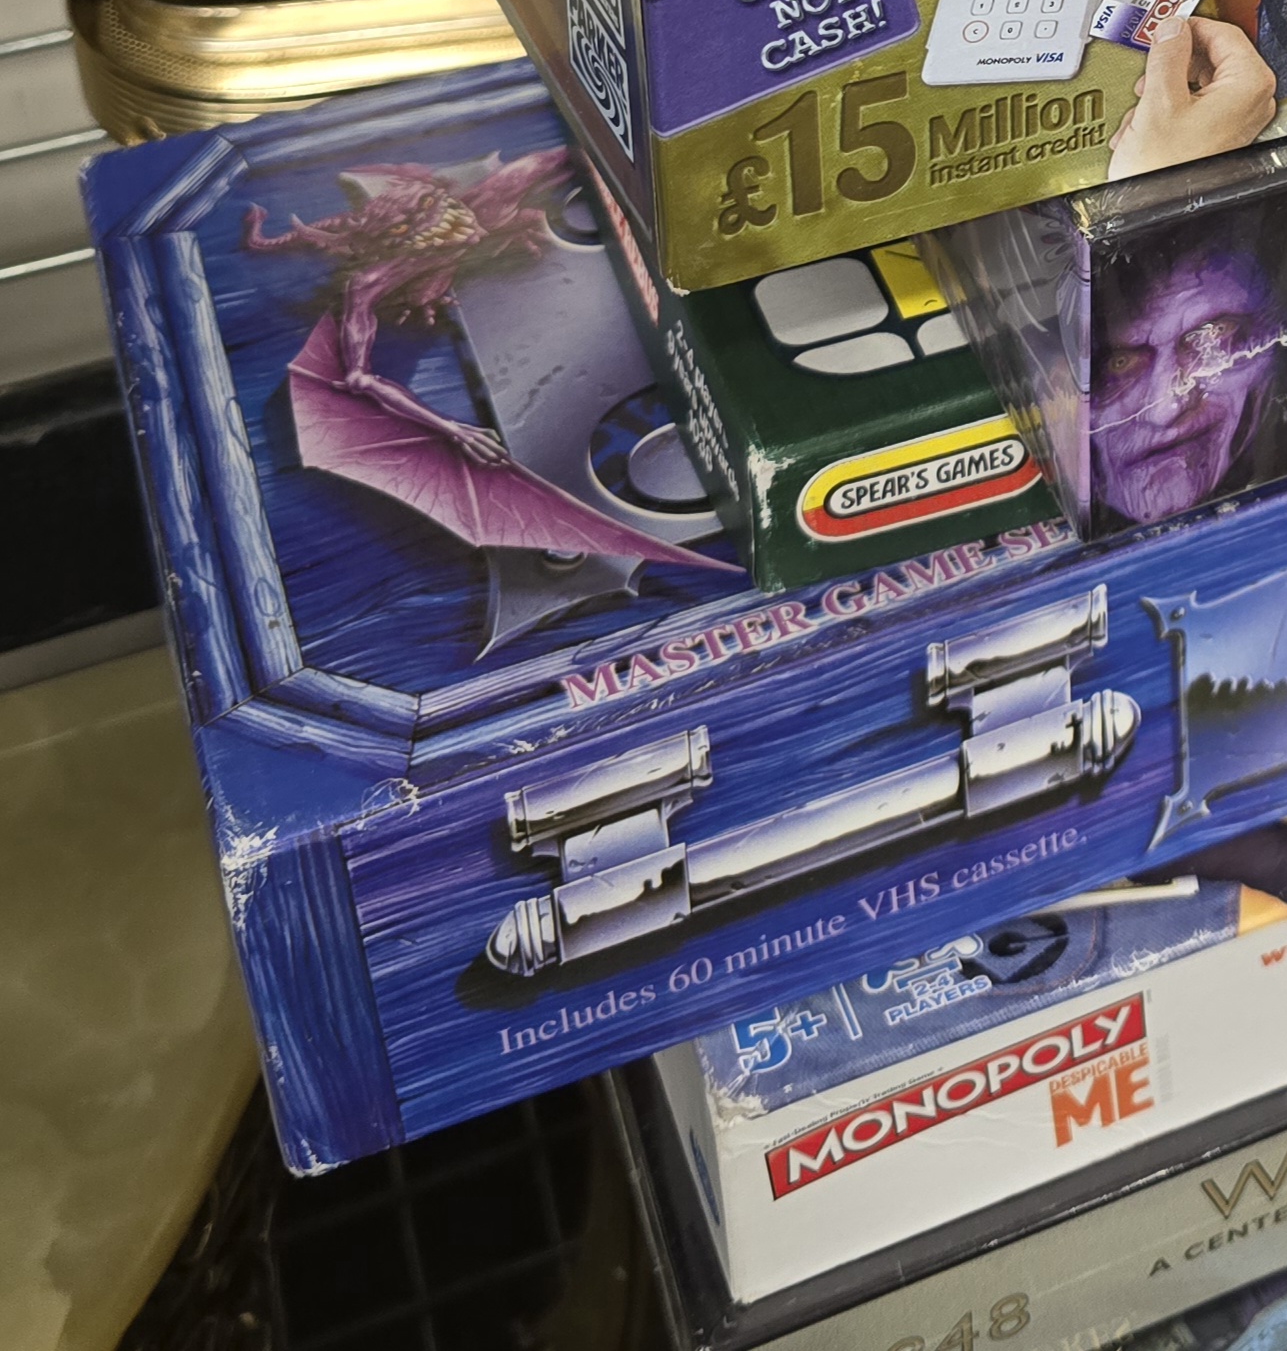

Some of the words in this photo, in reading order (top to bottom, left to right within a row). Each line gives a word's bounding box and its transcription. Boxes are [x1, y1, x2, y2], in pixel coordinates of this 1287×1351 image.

[1093, 4, 1117, 32] VISA
[977, 55, 1032, 67] MONOPOLY
[1035, 52, 1065, 64] VISA
[717, 72, 918, 237] £15
[926, 85, 1107, 161] Million
[930, 142, 1022, 187] instant
[1025, 122, 1107, 168] credit!
[839, 459, 931, 515] SPEAR'S
[935, 442, 1017, 489] GAMES
[561, 600, 812, 707] MASTER
[824, 545, 998, 621] GAME
[999, 519, 1074, 562] SE
[497, 978, 658, 1057] Includes
[667, 956, 715, 995] 60
[723, 909, 849, 973] minute
[858, 870, 942, 919] VHS
[950, 823, 1091, 891] cassette.
[886, 975, 992, 1025] PLAYERS
[913, 974, 953, 995] 2-4
[732, 1007, 828, 1075] 5+
[1048, 1042, 1149, 1095] DESPICABLE
[787, 1003, 1133, 1185] MONOPOLY
[1050, 1058, 1156, 1149] ME
[1147, 1255, 1172, 1277] A
